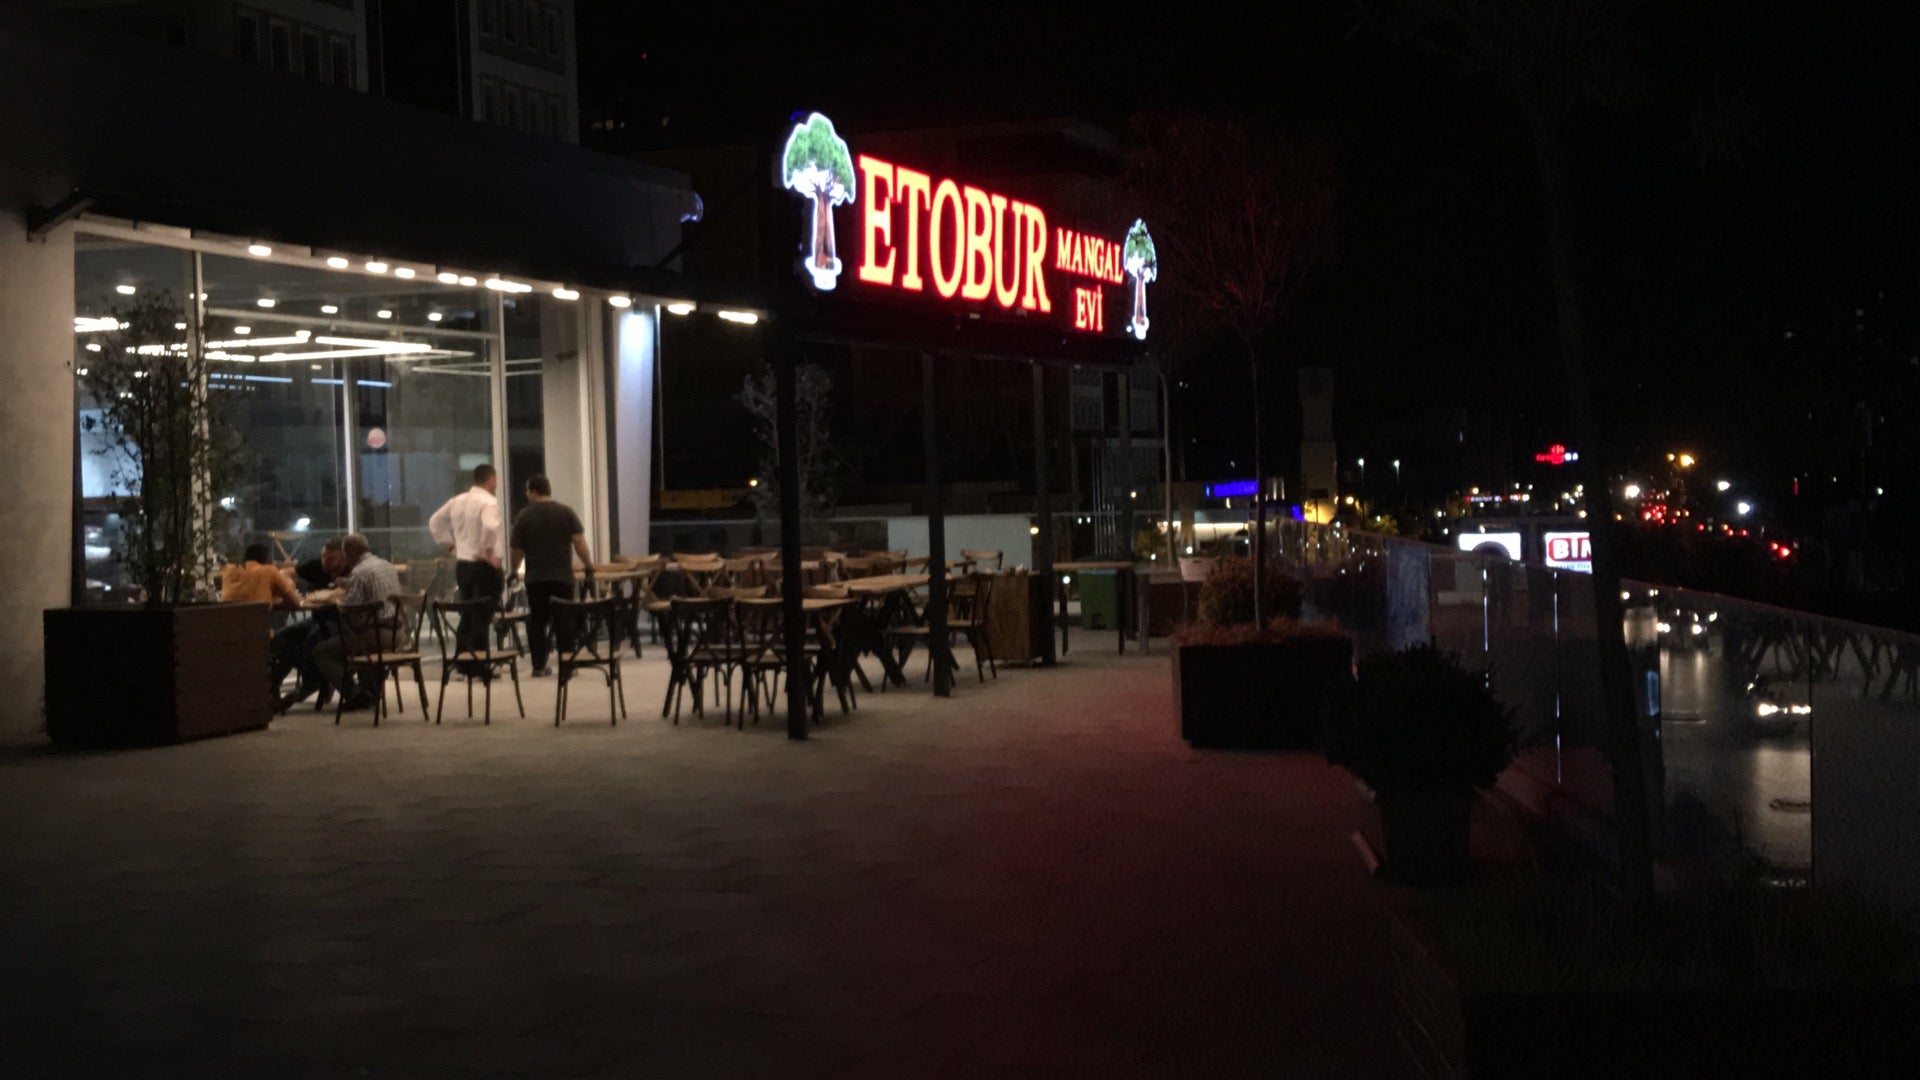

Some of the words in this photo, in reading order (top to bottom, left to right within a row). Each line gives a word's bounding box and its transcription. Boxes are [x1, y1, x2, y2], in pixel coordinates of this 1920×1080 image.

[859, 154, 1051, 313] ETOBUR
[1056, 228, 1124, 283] MANGAL
[1075, 286, 1103, 331] EVİ
